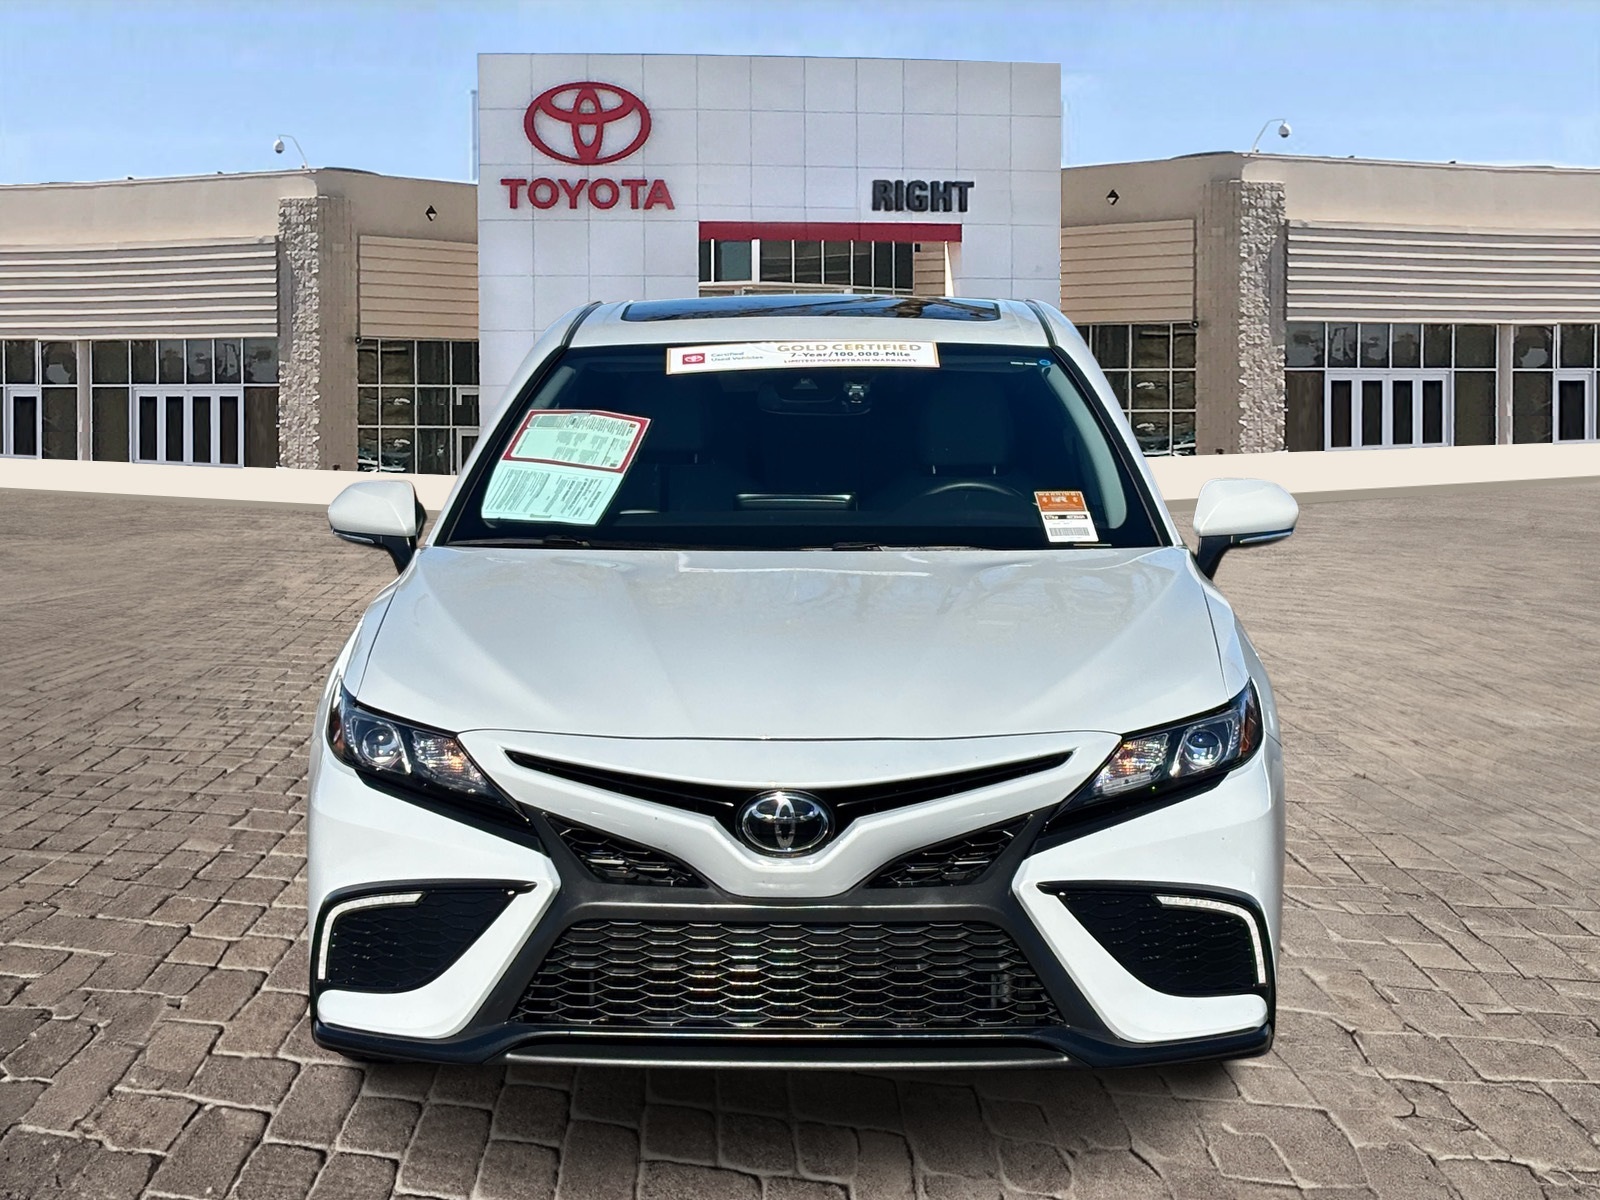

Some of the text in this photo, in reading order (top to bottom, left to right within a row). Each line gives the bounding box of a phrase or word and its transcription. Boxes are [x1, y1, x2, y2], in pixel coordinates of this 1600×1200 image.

[500, 178, 675, 210] TOYOTA
[871, 179, 975, 213] RIGHT
[777, 343, 922, 352] GOLD CERTIFIED
